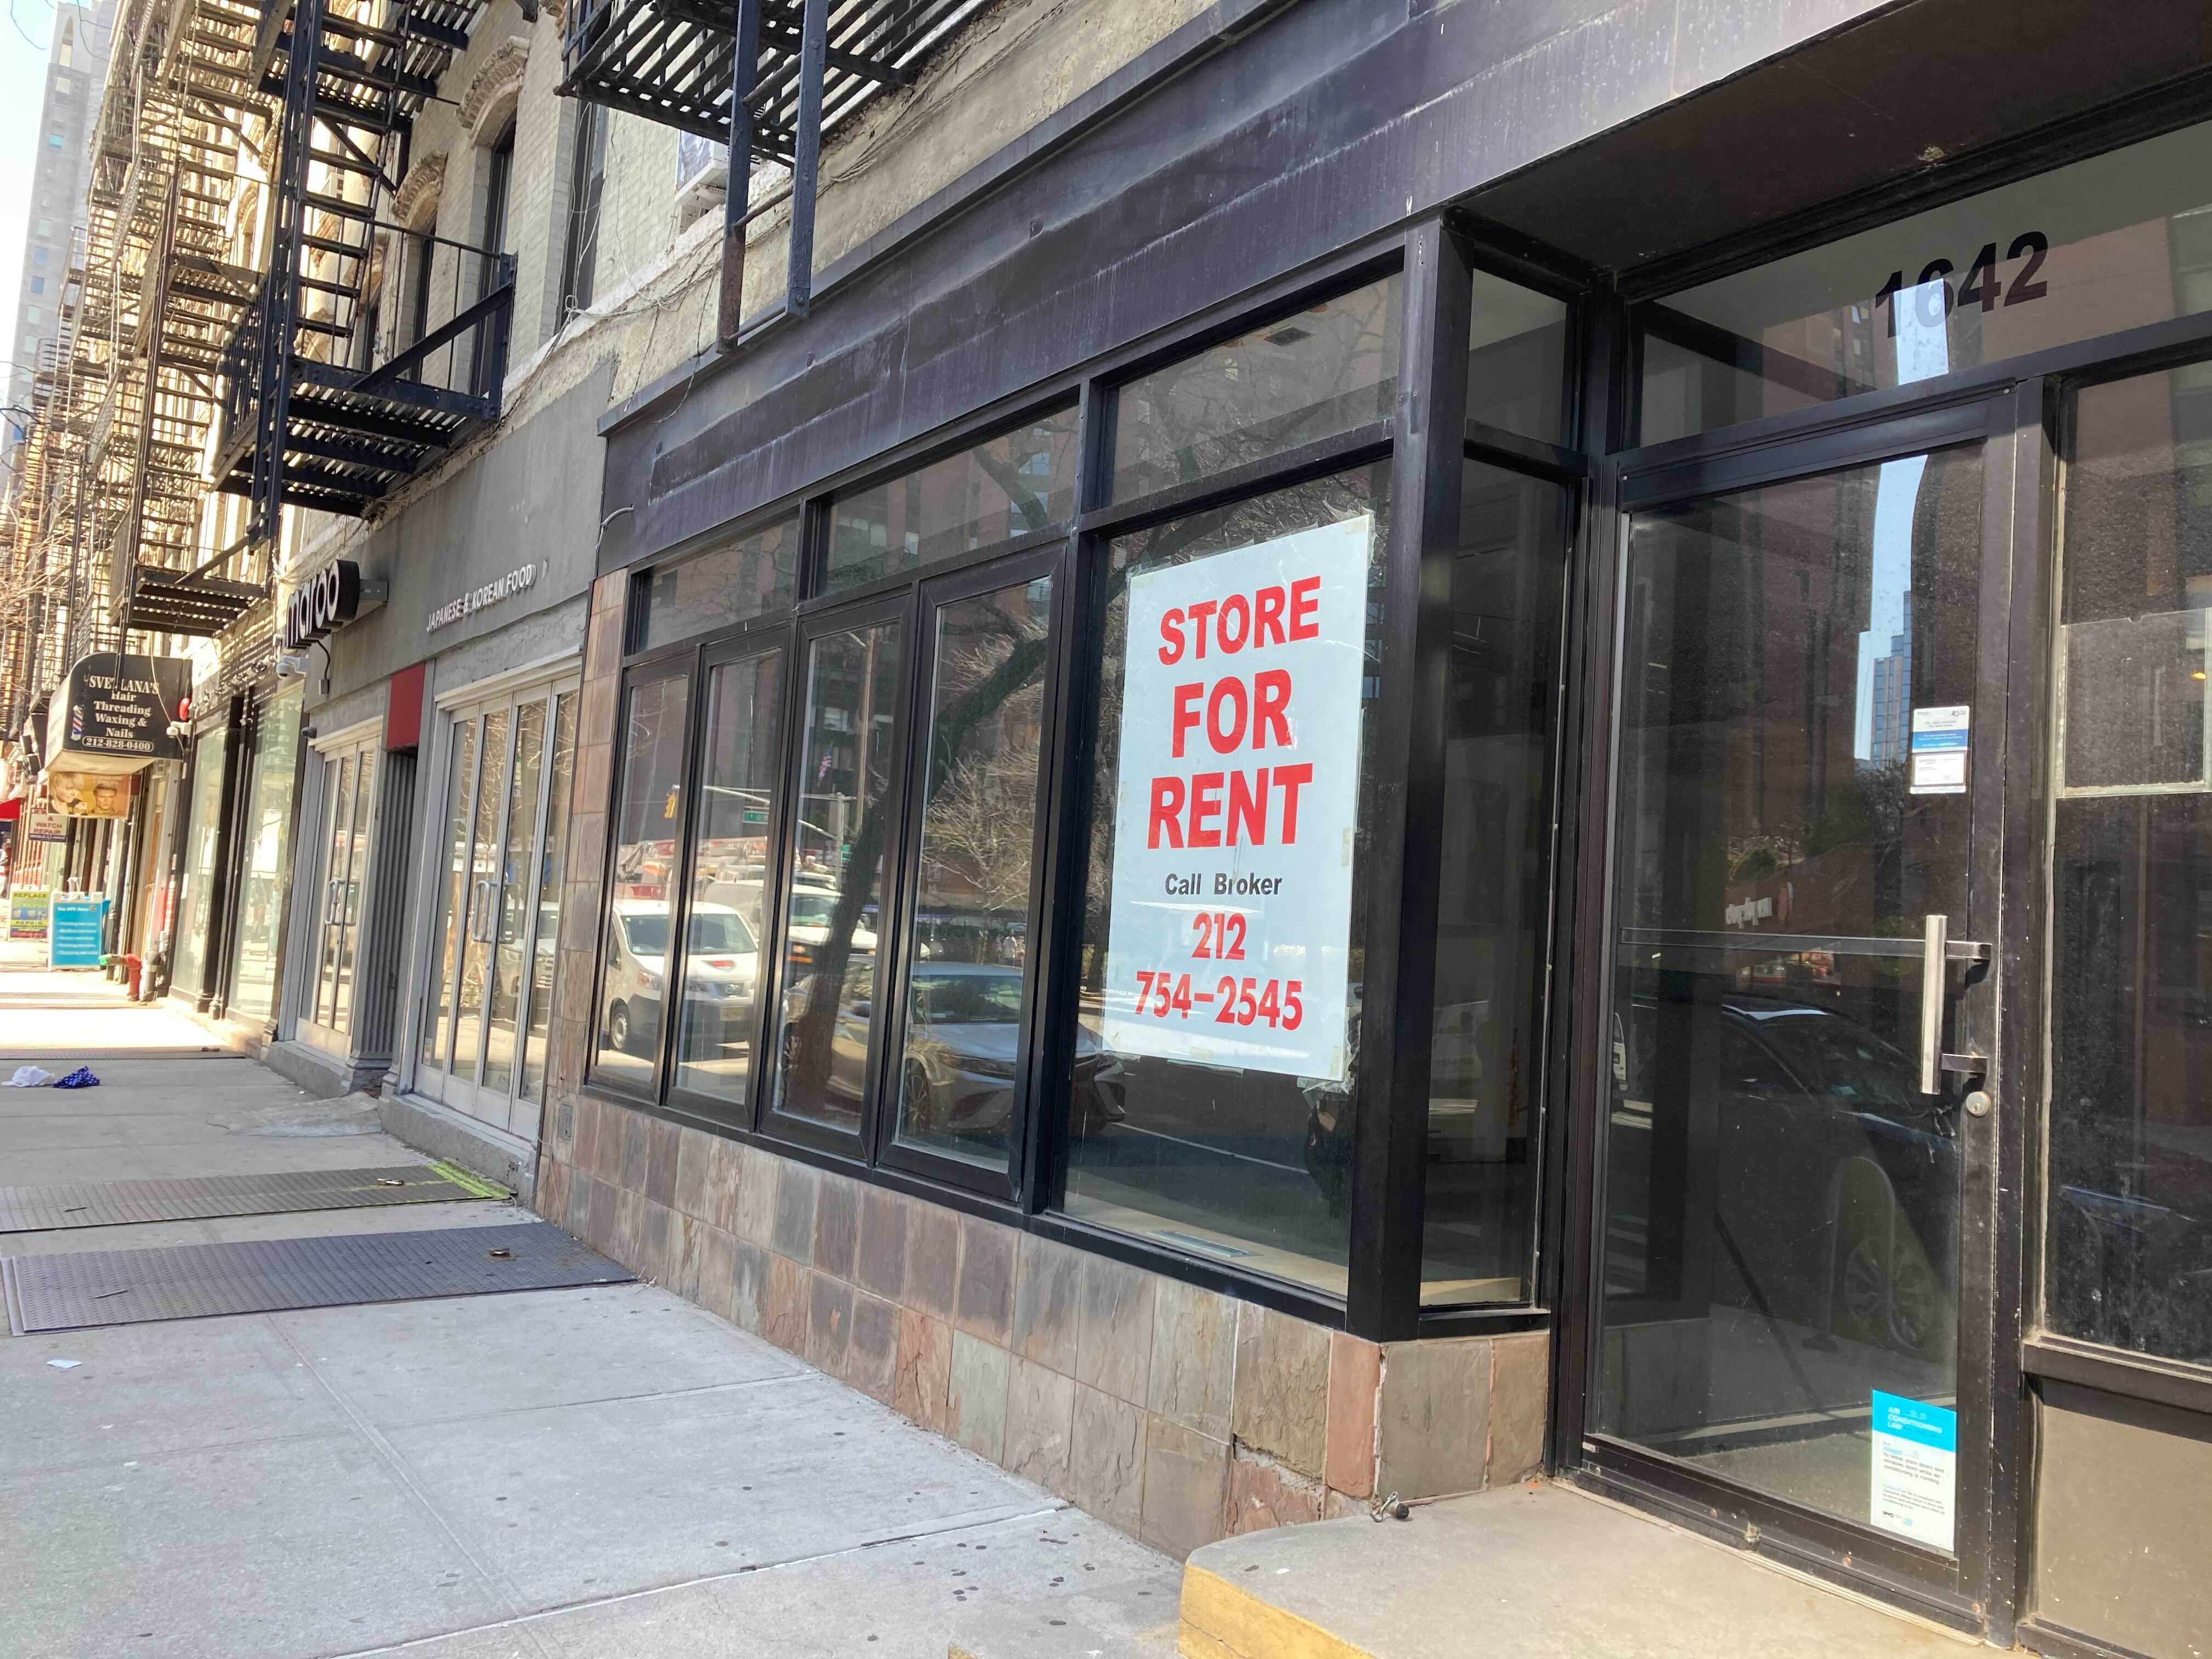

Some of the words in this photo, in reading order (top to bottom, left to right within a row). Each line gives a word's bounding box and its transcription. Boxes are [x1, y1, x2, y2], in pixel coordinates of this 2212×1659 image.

[1875, 230, 2049, 338] 1642
[286, 560, 344, 649] maroo
[426, 598, 462, 632] JAPANESE
[464, 592, 470, 614] &
[472, 578, 504, 610] KOREAN
[506, 564, 534, 594] FOOD
[1158, 575, 1321, 666] STORE
[89, 675, 159, 695] SVELANA'S
[94, 701, 151, 718] Threading
[111, 691, 137, 702] Hair
[95, 713, 136, 727] Waxing
[137, 718, 148, 727] &
[105, 727, 133, 738] Nails
[1171, 668, 1293, 759] FOR
[85, 737, 151, 752] 212-828-0400
[1147, 762, 1313, 850] RENT
[1165, 873, 1201, 895] Call
[1214, 872, 1283, 895] Broker
[1190, 912, 1247, 961] 212
[1134, 970, 1303, 1031] 754-2545
